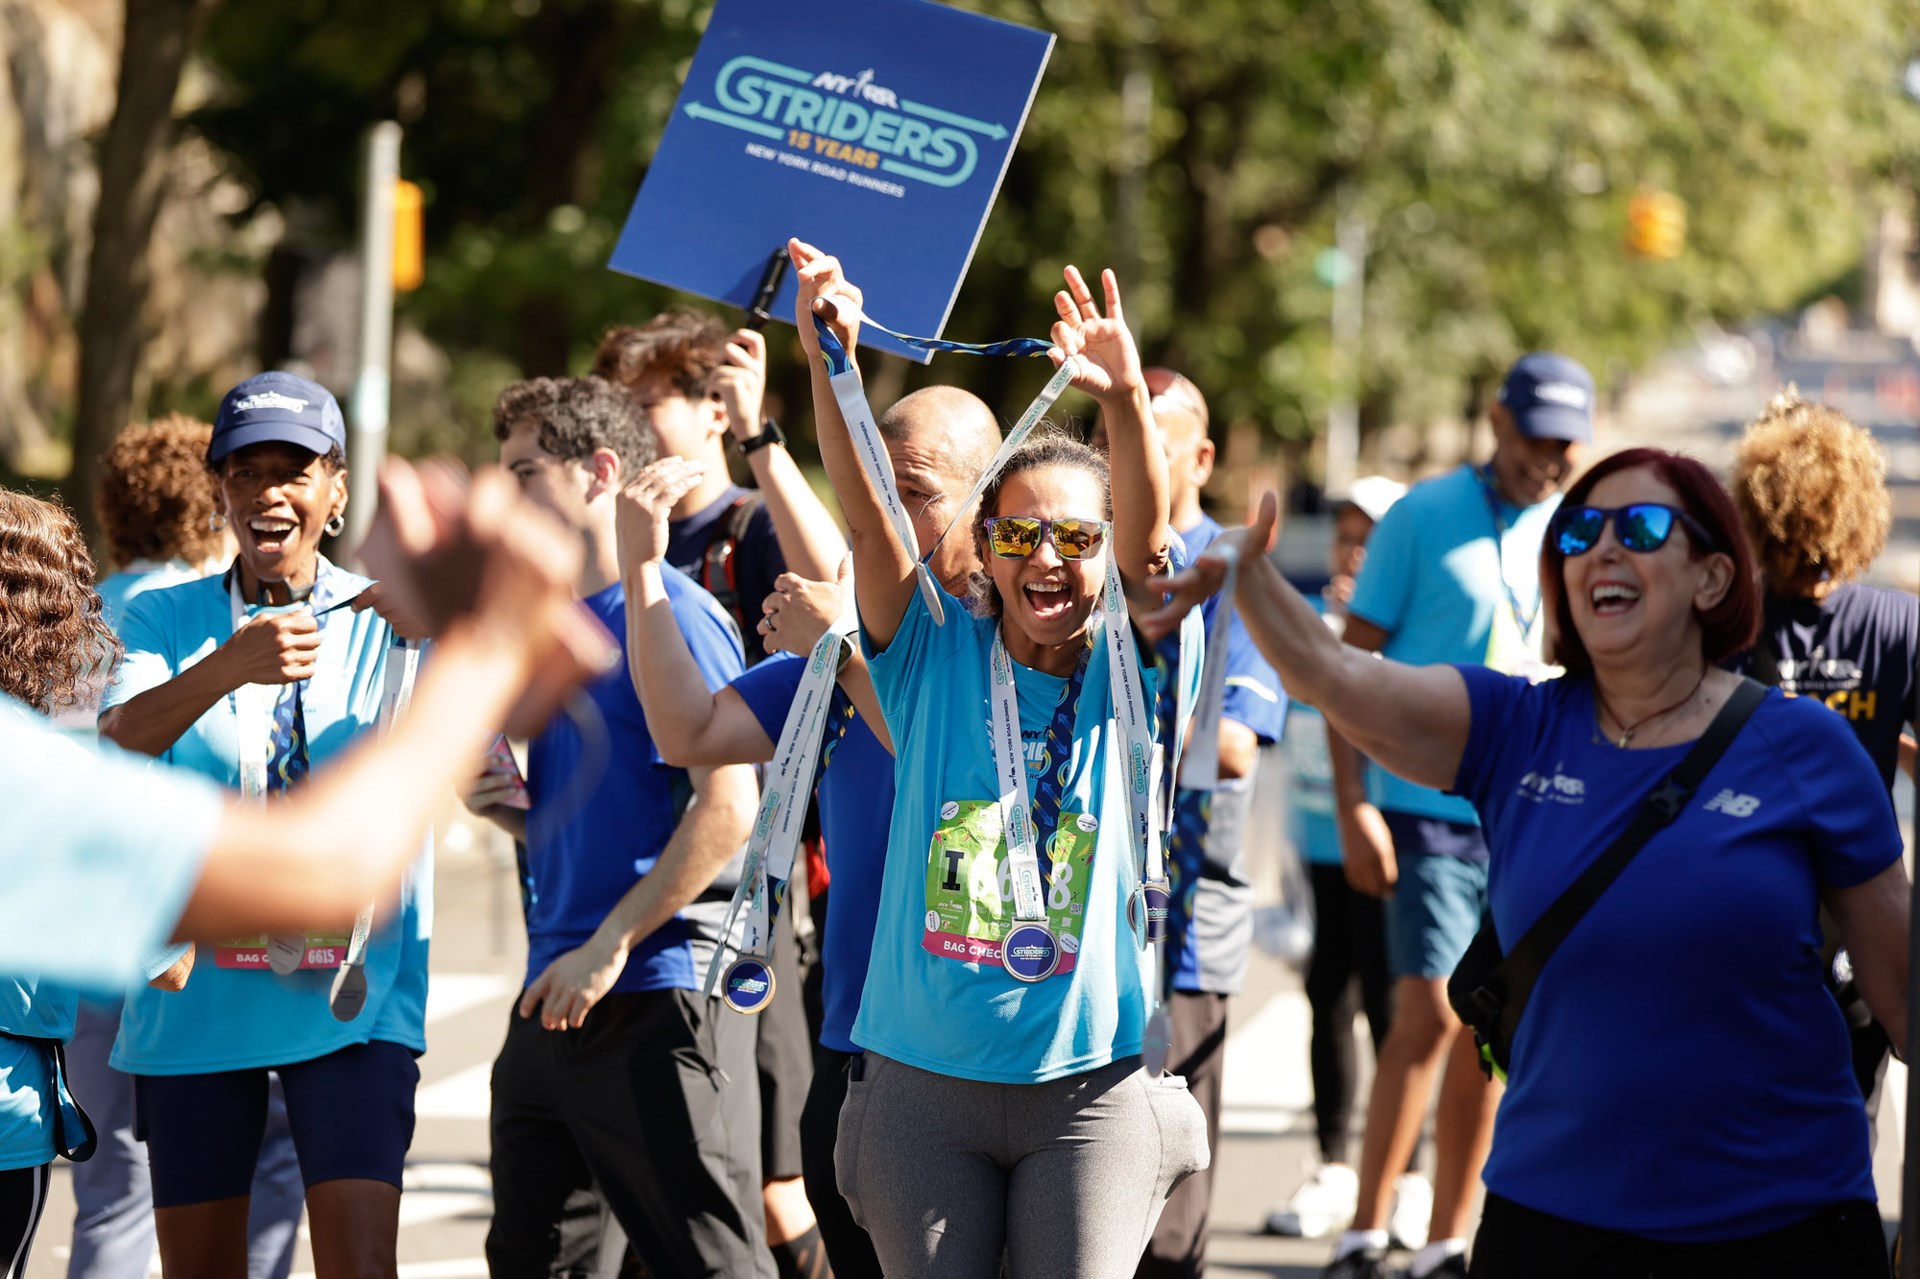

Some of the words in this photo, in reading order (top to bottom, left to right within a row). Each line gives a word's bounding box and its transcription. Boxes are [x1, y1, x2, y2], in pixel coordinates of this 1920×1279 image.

[733, 72, 960, 170] STRIDERS
[745, 142, 778, 161] NEW
[777, 151, 812, 172] YORK
[810, 161, 848, 182] ROAD
[847, 171, 906, 198] RUNNERS
[787, 129, 811, 150] 15
[814, 136, 881, 170] YEARS
[869, 446, 878, 462] ROAD
[1134, 744, 1144, 794] STRIDERS
[1014, 805, 1025, 853] STRIDERS
[1023, 872, 1035, 919] STRIDERS
[236, 953, 260, 963] BAG
[308, 948, 335, 964] 6615
[943, 940, 966, 953] BAG
[968, 945, 1002, 959] CHEC
